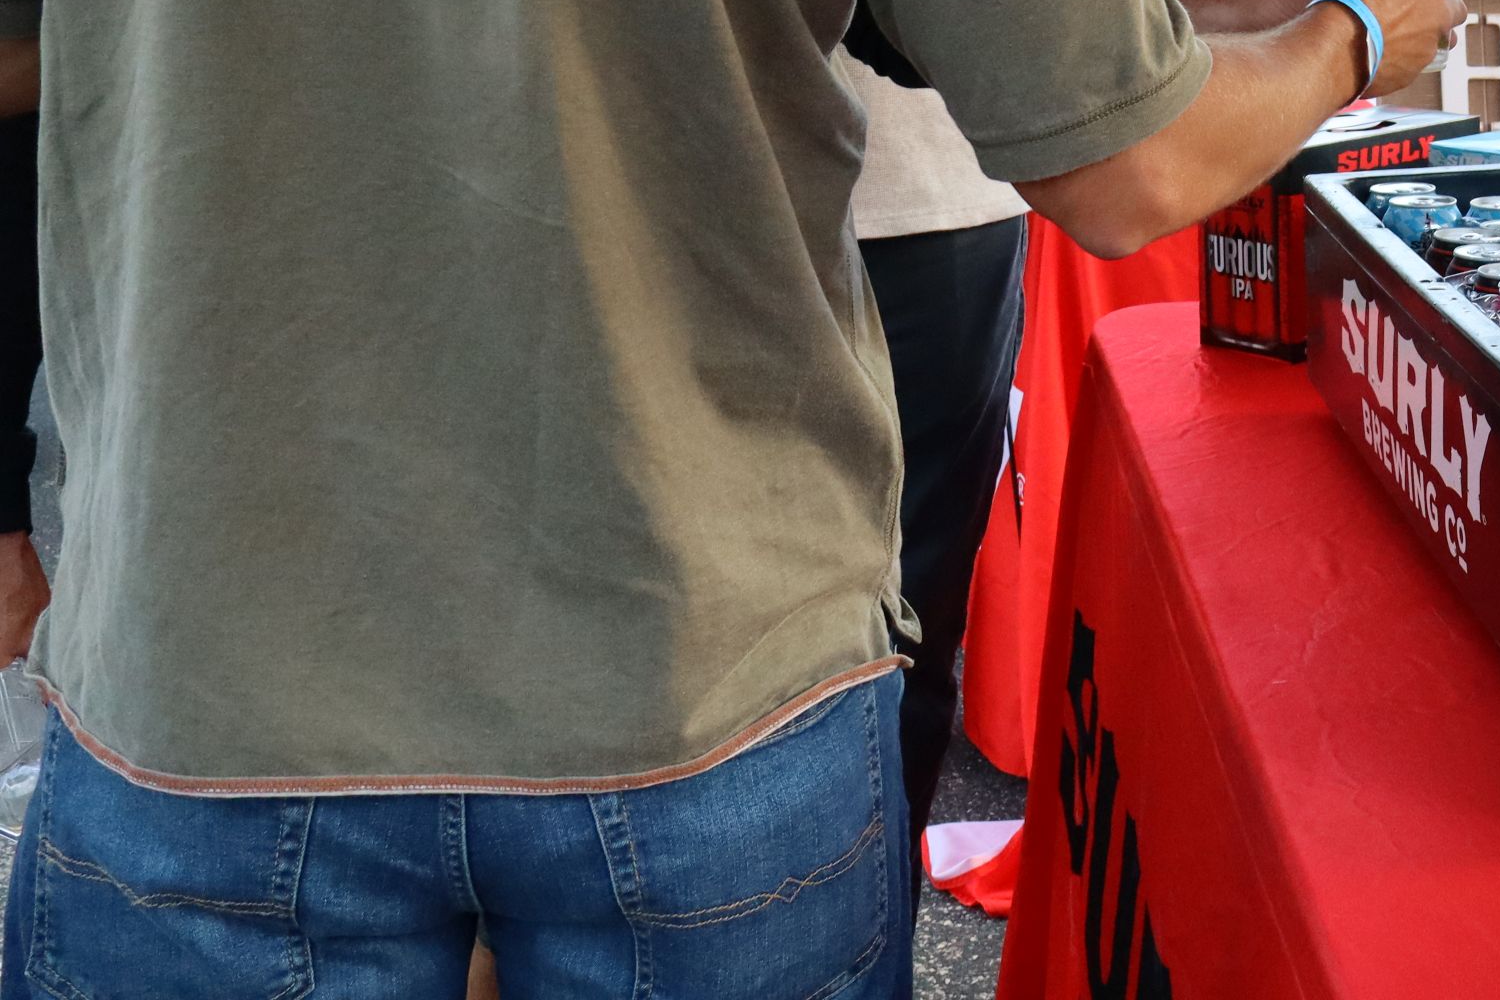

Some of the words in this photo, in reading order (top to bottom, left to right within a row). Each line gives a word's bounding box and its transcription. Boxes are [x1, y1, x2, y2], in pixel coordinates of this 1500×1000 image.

[1337, 134, 1435, 173] SURLY
[1208, 233, 1275, 283] FURIOUS
[1231, 277, 1255, 301] IPA
[1341, 278, 1492, 524] SURLY
[1361, 396, 1440, 534] BREWING
